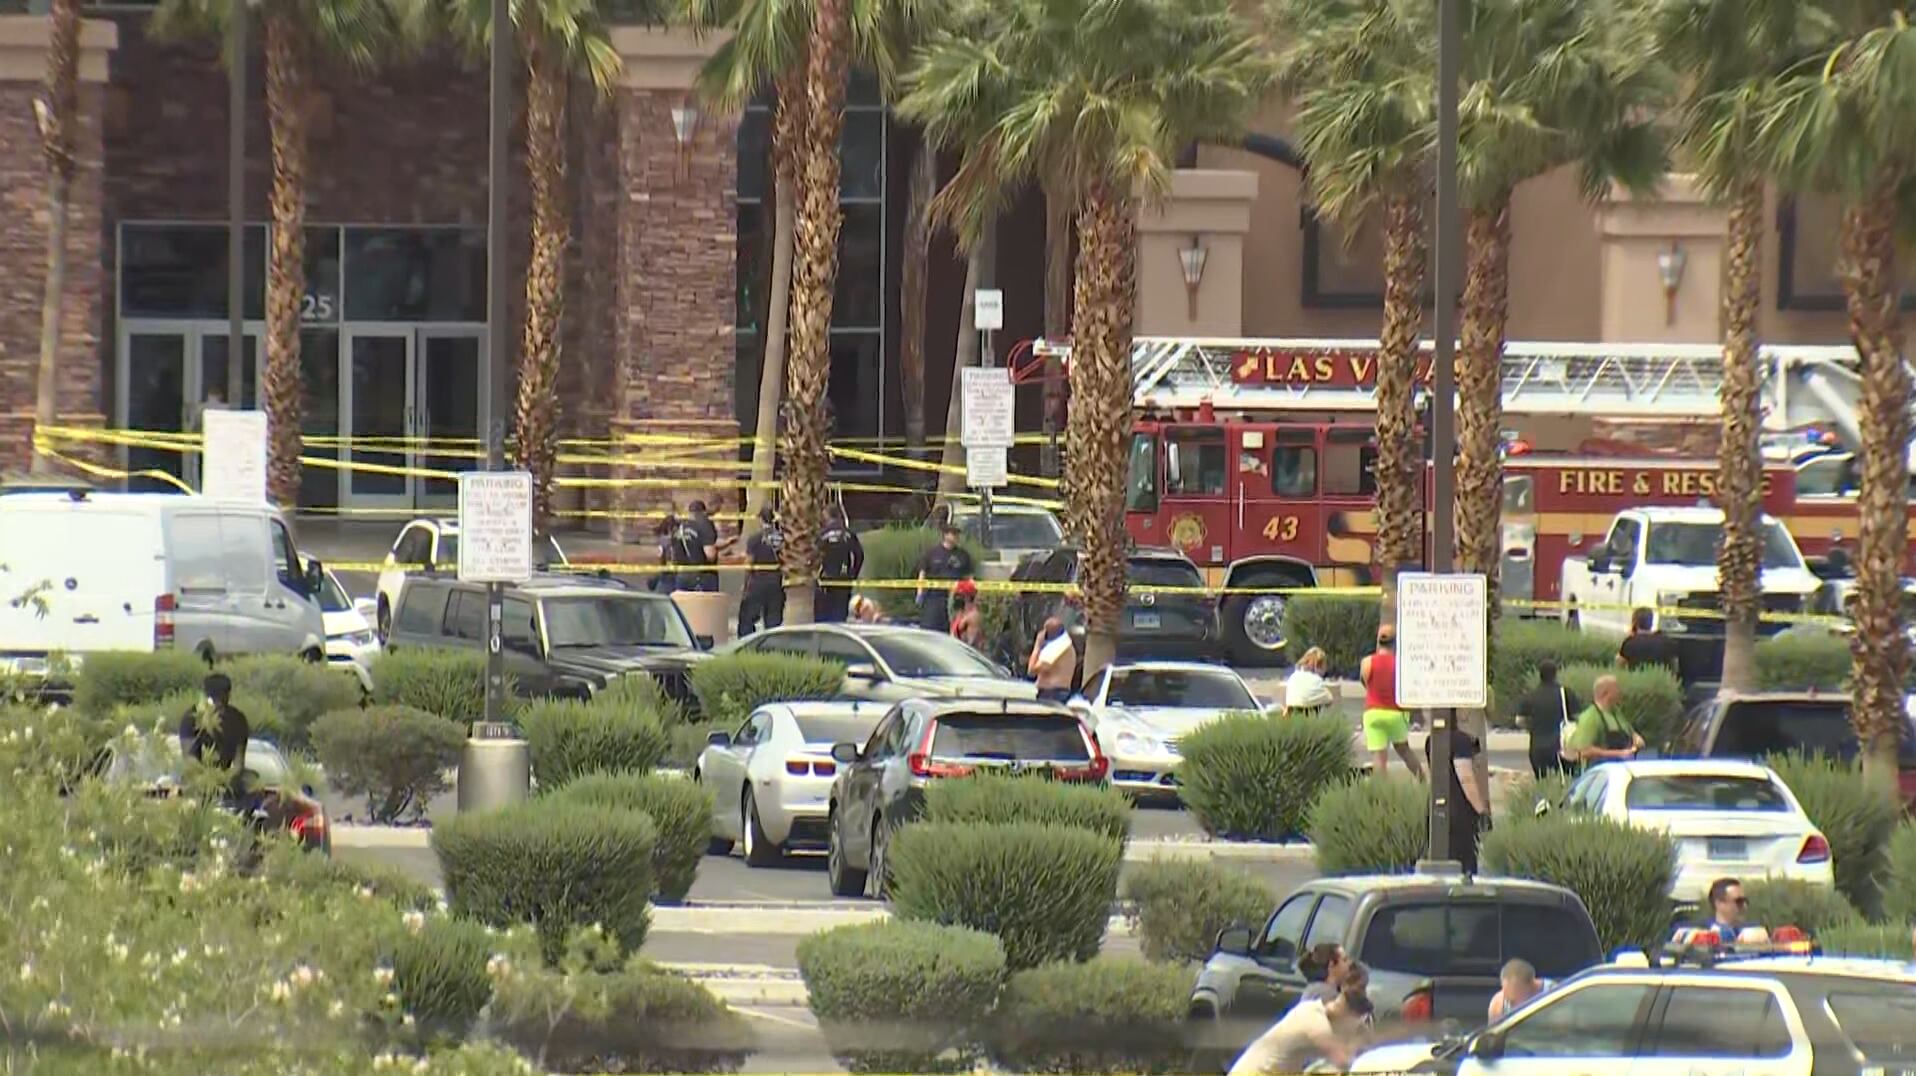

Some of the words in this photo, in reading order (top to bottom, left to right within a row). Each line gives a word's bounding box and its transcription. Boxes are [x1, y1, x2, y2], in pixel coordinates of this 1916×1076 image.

[1265, 355, 1334, 381] LAS
[1559, 470, 1624, 494] FIRE
[1632, 471, 1650, 494] &
[1663, 471, 1773, 495] RESE
[1262, 515, 1299, 541] 43
